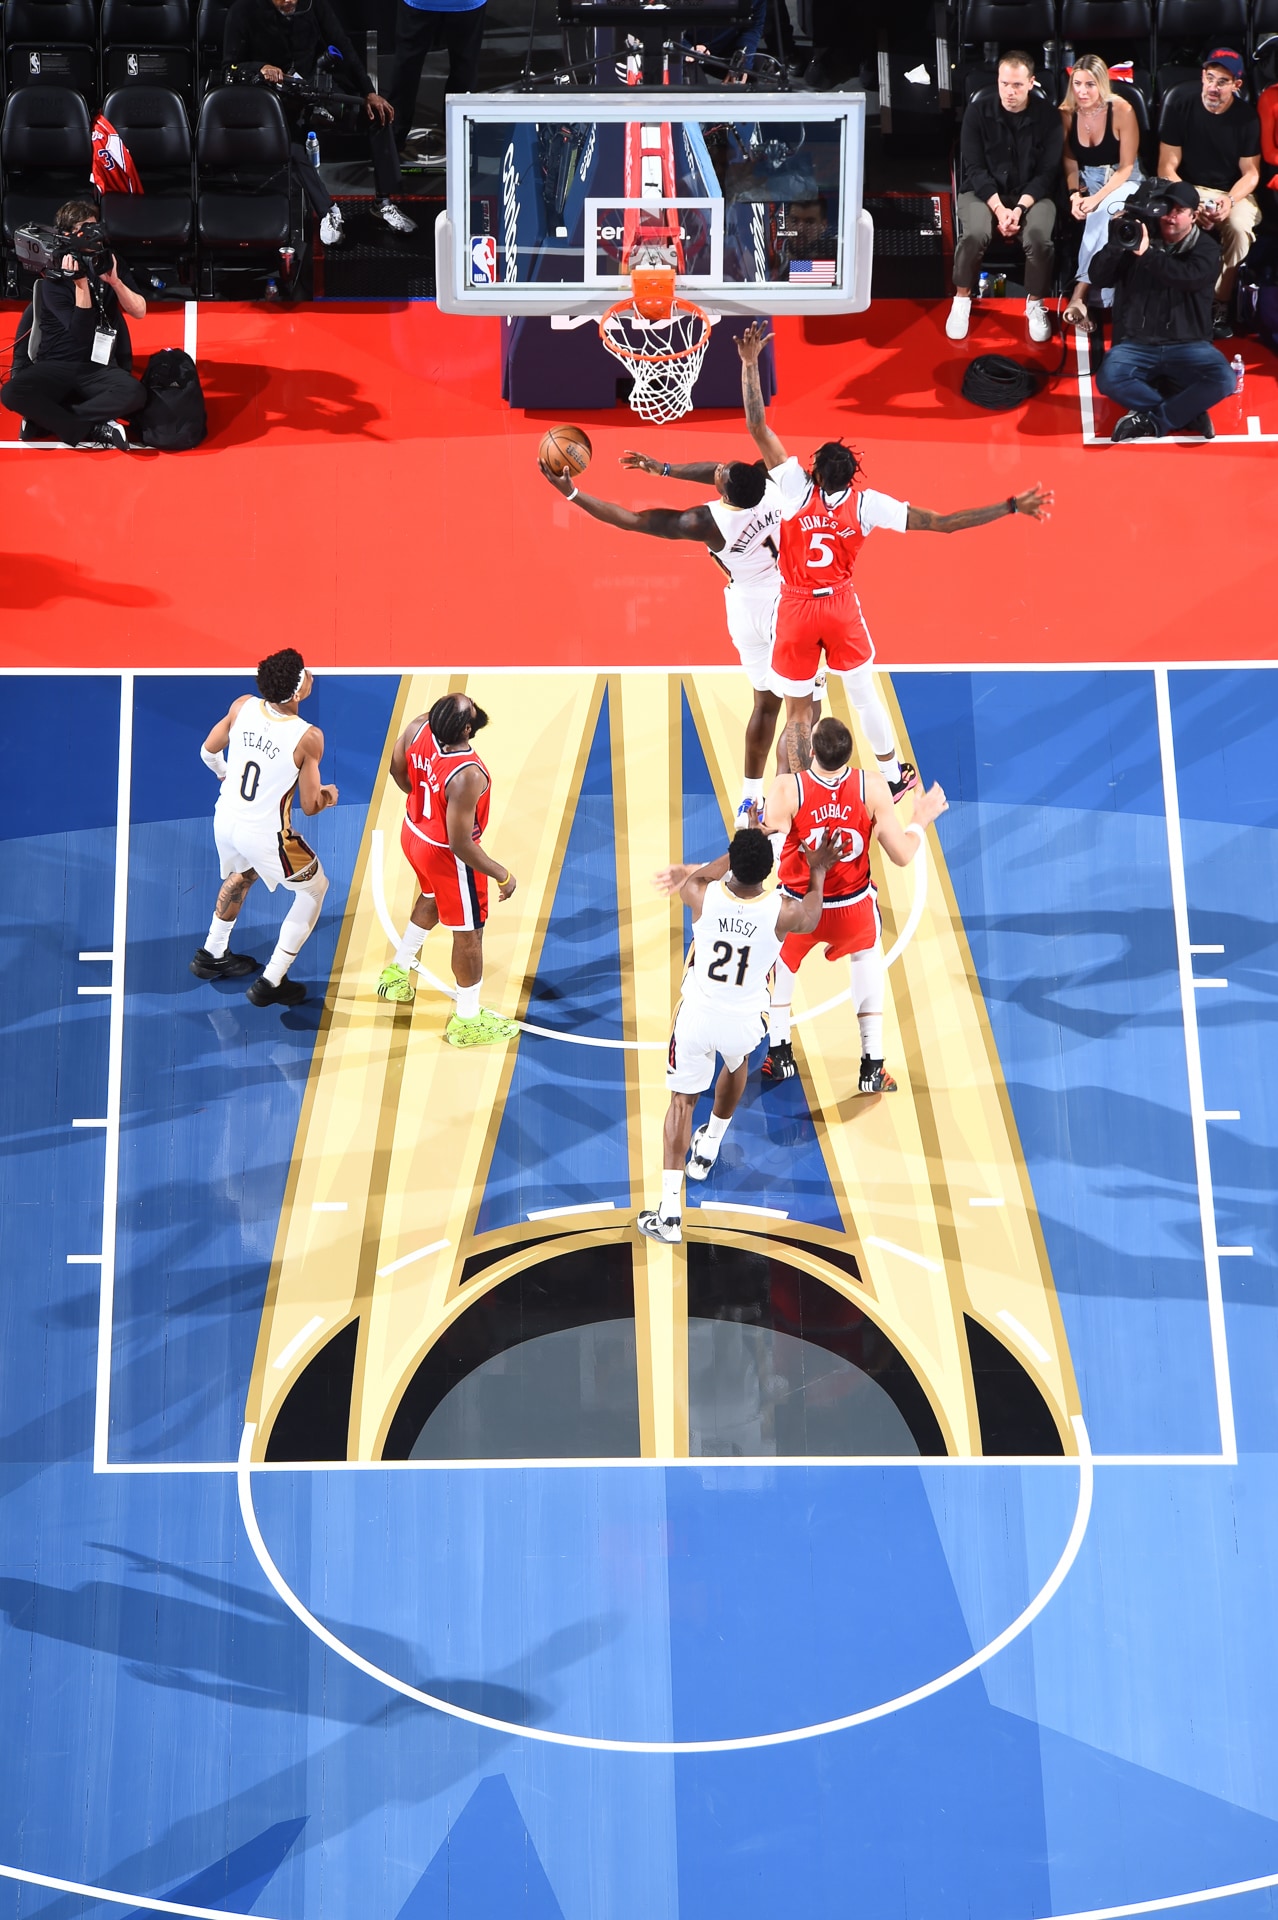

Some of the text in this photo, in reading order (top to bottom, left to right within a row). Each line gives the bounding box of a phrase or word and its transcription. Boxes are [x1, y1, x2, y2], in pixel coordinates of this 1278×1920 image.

[98, 149, 115, 170] 3
[26, 240, 40, 254] 10
[474, 273, 487, 282] NBA
[798, 514, 856, 539] JONES JR
[806, 533, 836, 568] 5
[243, 731, 280, 760] FEARS
[240, 760, 261, 801] 0
[419, 781, 432, 820] 1
[811, 803, 852, 824] ZUBAC
[718, 917, 758, 939] MISSI
[707, 941, 751, 987] 21
